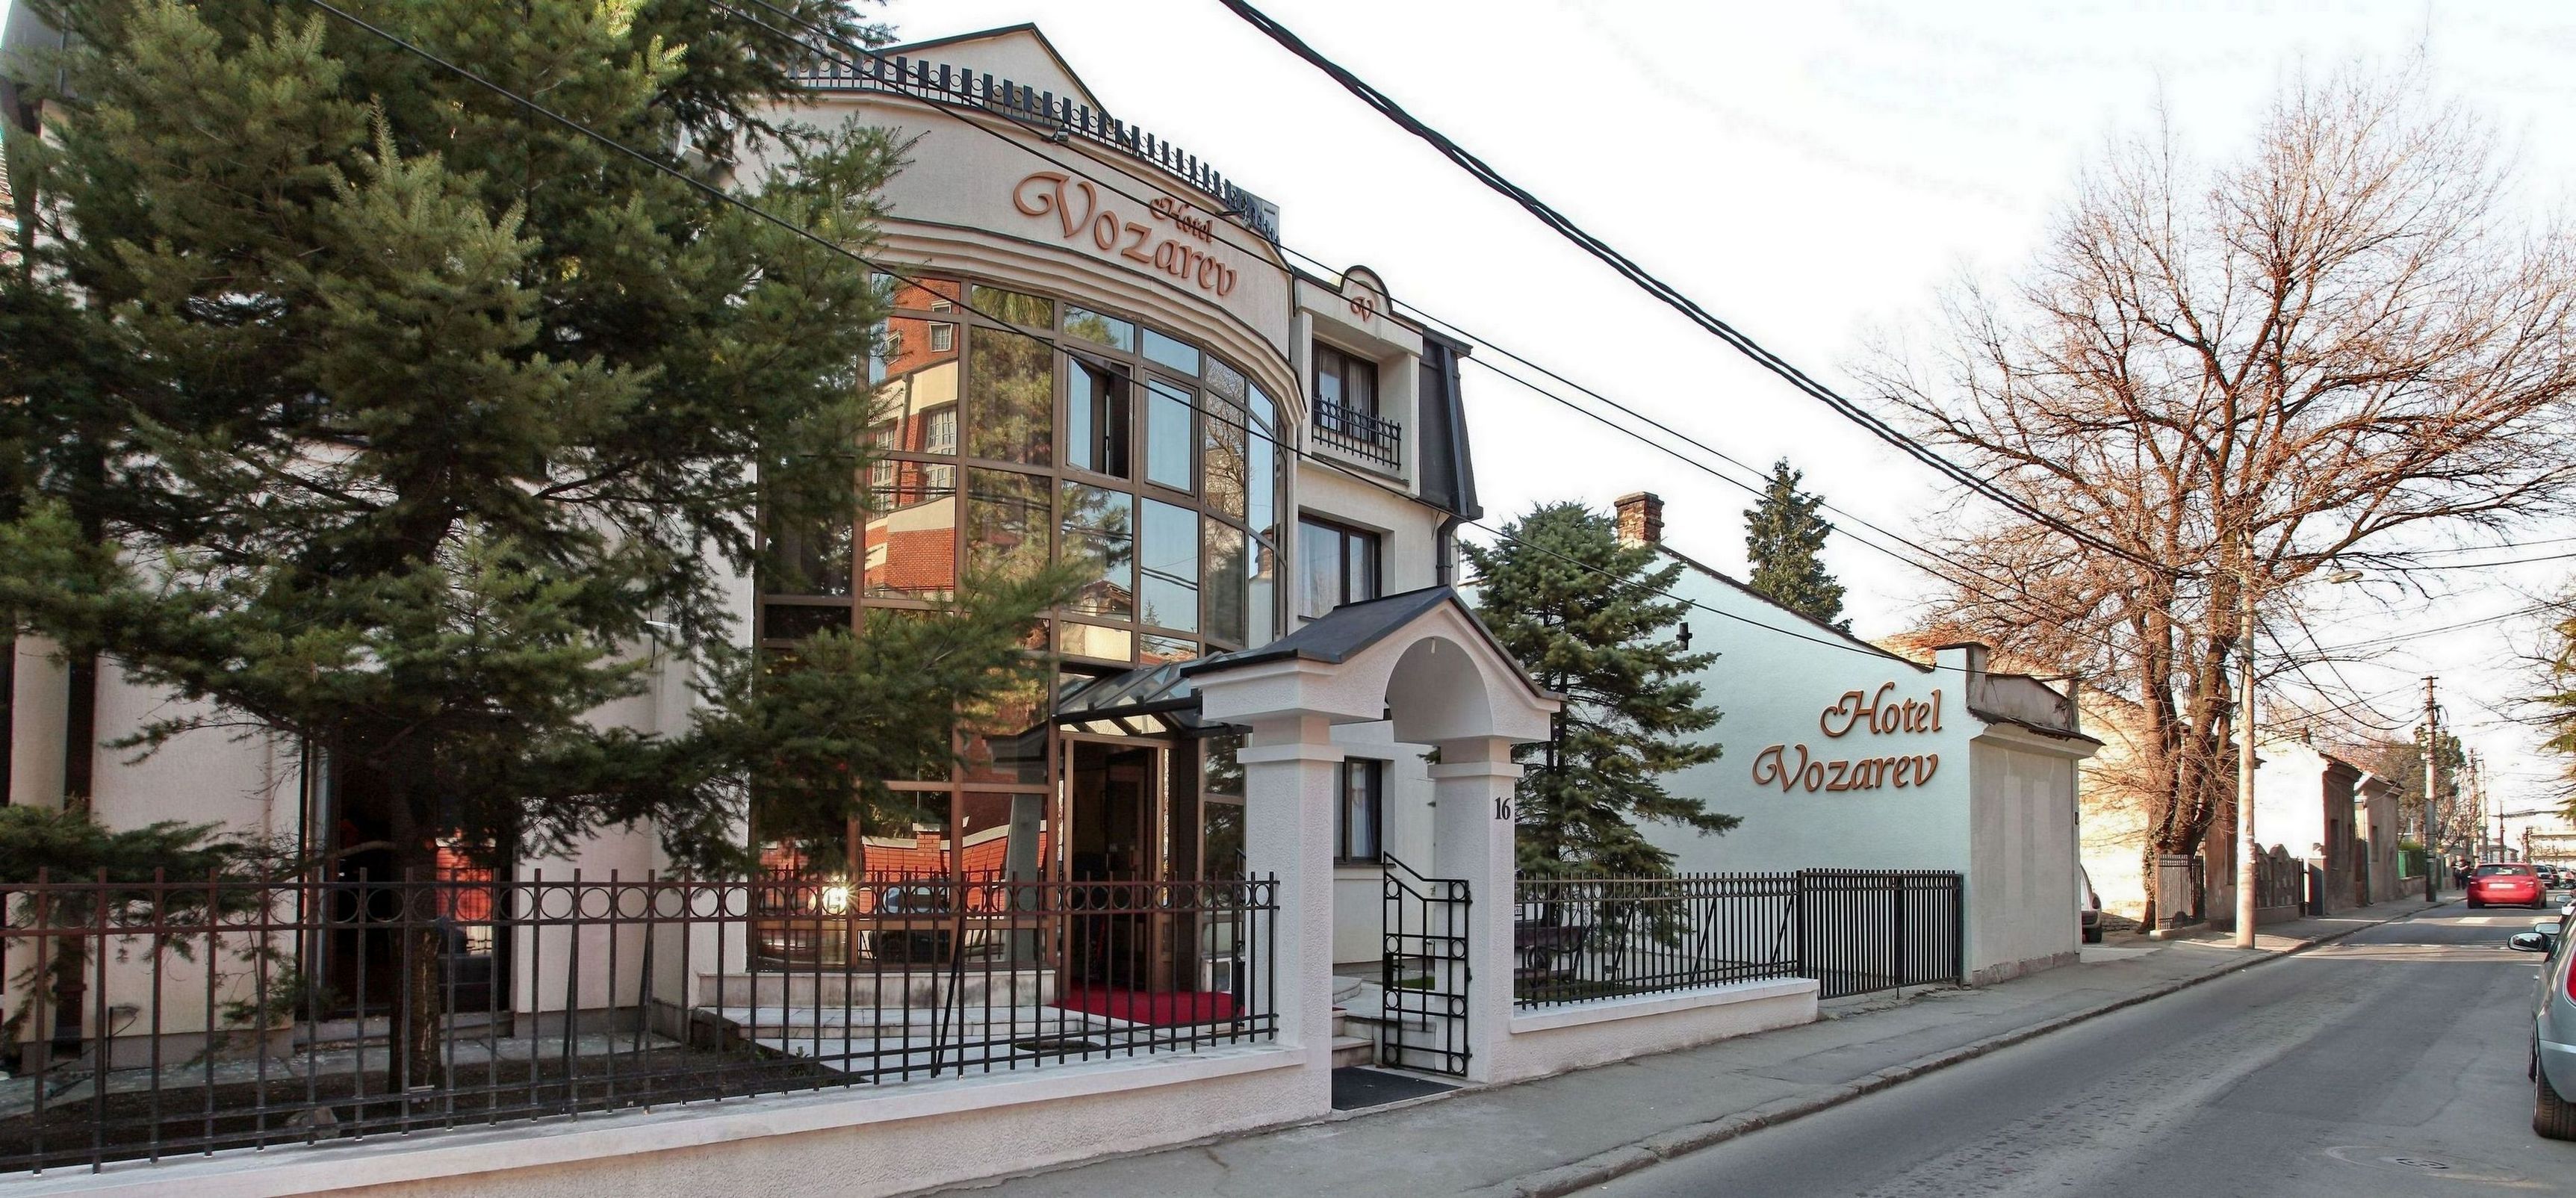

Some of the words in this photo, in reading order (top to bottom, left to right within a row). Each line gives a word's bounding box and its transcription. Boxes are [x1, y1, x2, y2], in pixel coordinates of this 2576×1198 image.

[1013, 170, 1238, 297] Vozarev
[1149, 196, 1213, 243] Hotel
[1819, 681, 1942, 737] Hotel
[1751, 744, 1939, 792] Vozarev
[1495, 795, 1512, 820] 16
